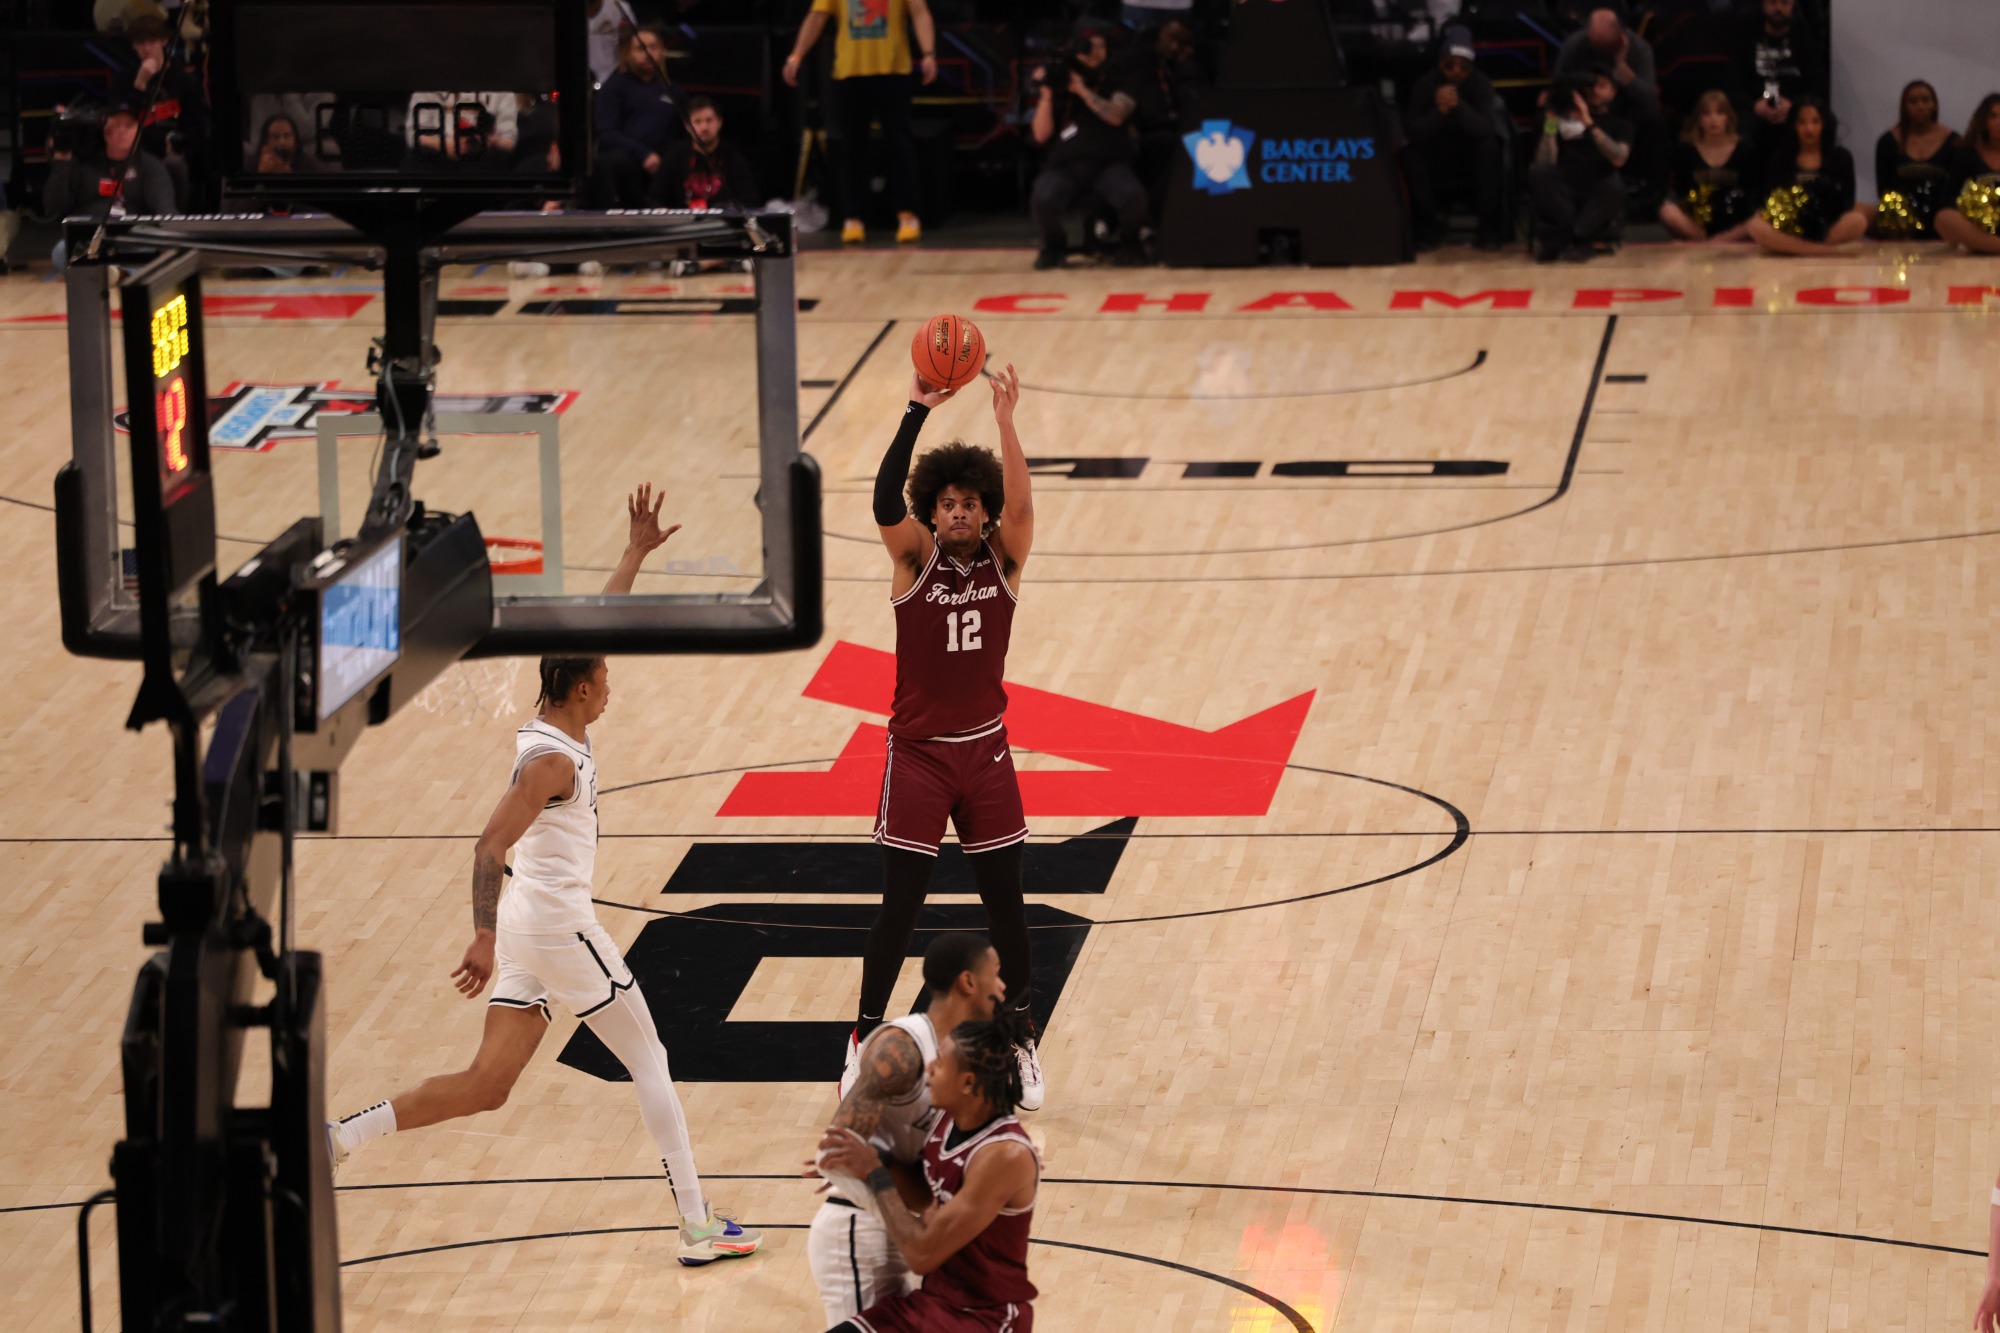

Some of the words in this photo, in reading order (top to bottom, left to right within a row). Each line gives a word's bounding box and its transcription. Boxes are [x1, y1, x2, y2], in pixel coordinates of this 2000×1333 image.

[1260, 138, 1375, 160] BARCLAYS
[1260, 161, 1353, 183] CENTER
[925, 580, 998, 605] Fordham
[946, 609, 982, 652] 12
